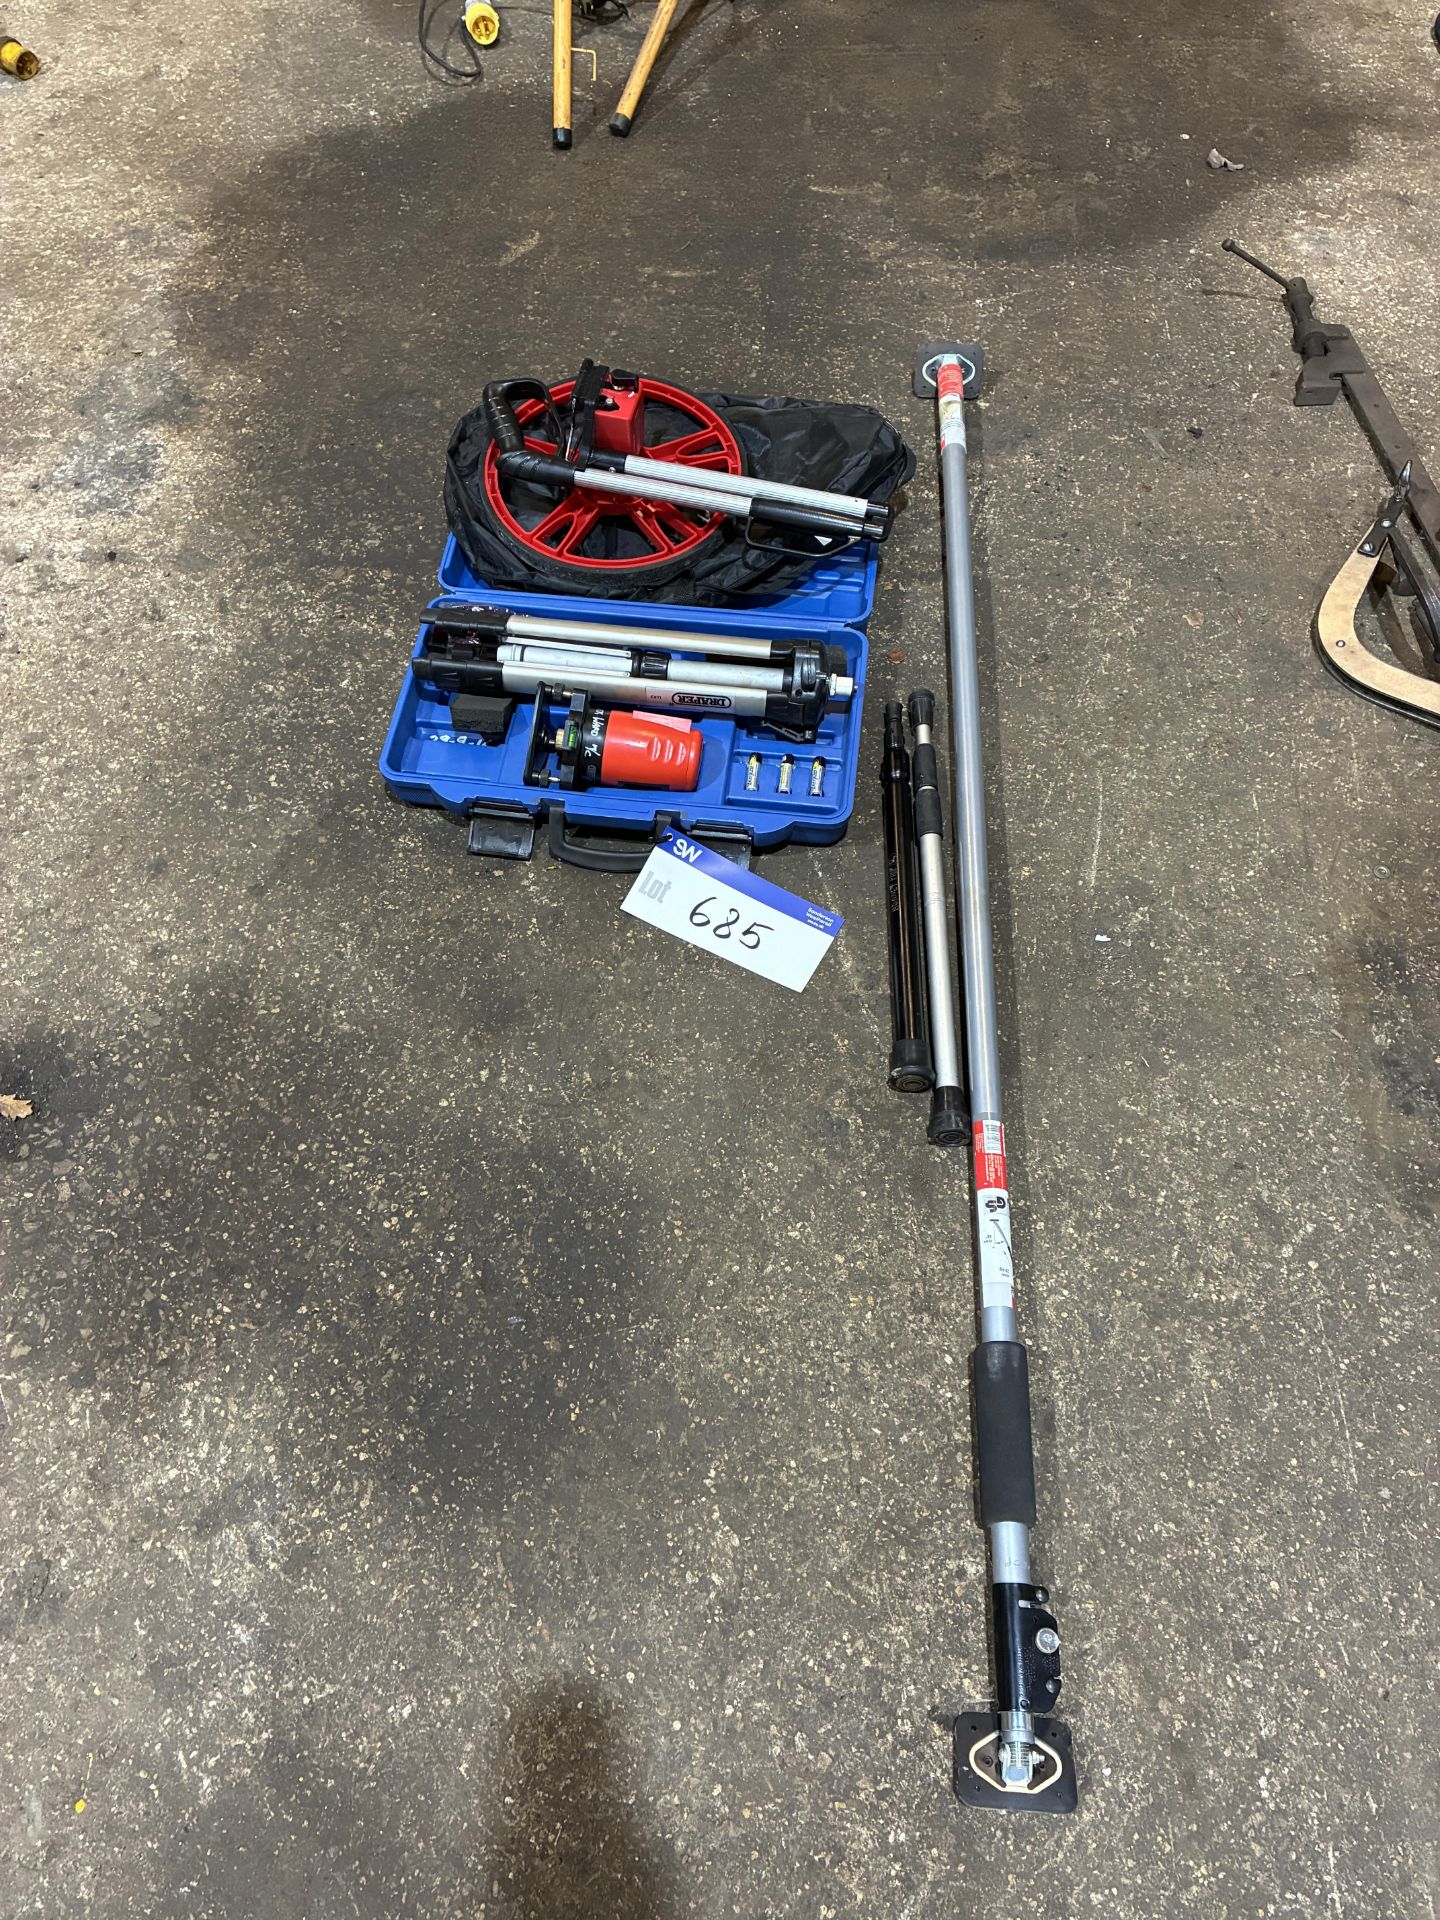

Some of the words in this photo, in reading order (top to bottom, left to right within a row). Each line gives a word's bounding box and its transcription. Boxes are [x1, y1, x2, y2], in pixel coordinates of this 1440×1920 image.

[677, 694, 727, 707] DRAPER
[590, 716, 605, 737] WARD
[672, 838, 703, 863] SW
[638, 870, 672, 904] Lot
[689, 896, 775, 950] 685
[807, 907, 834, 922] Sanderson
